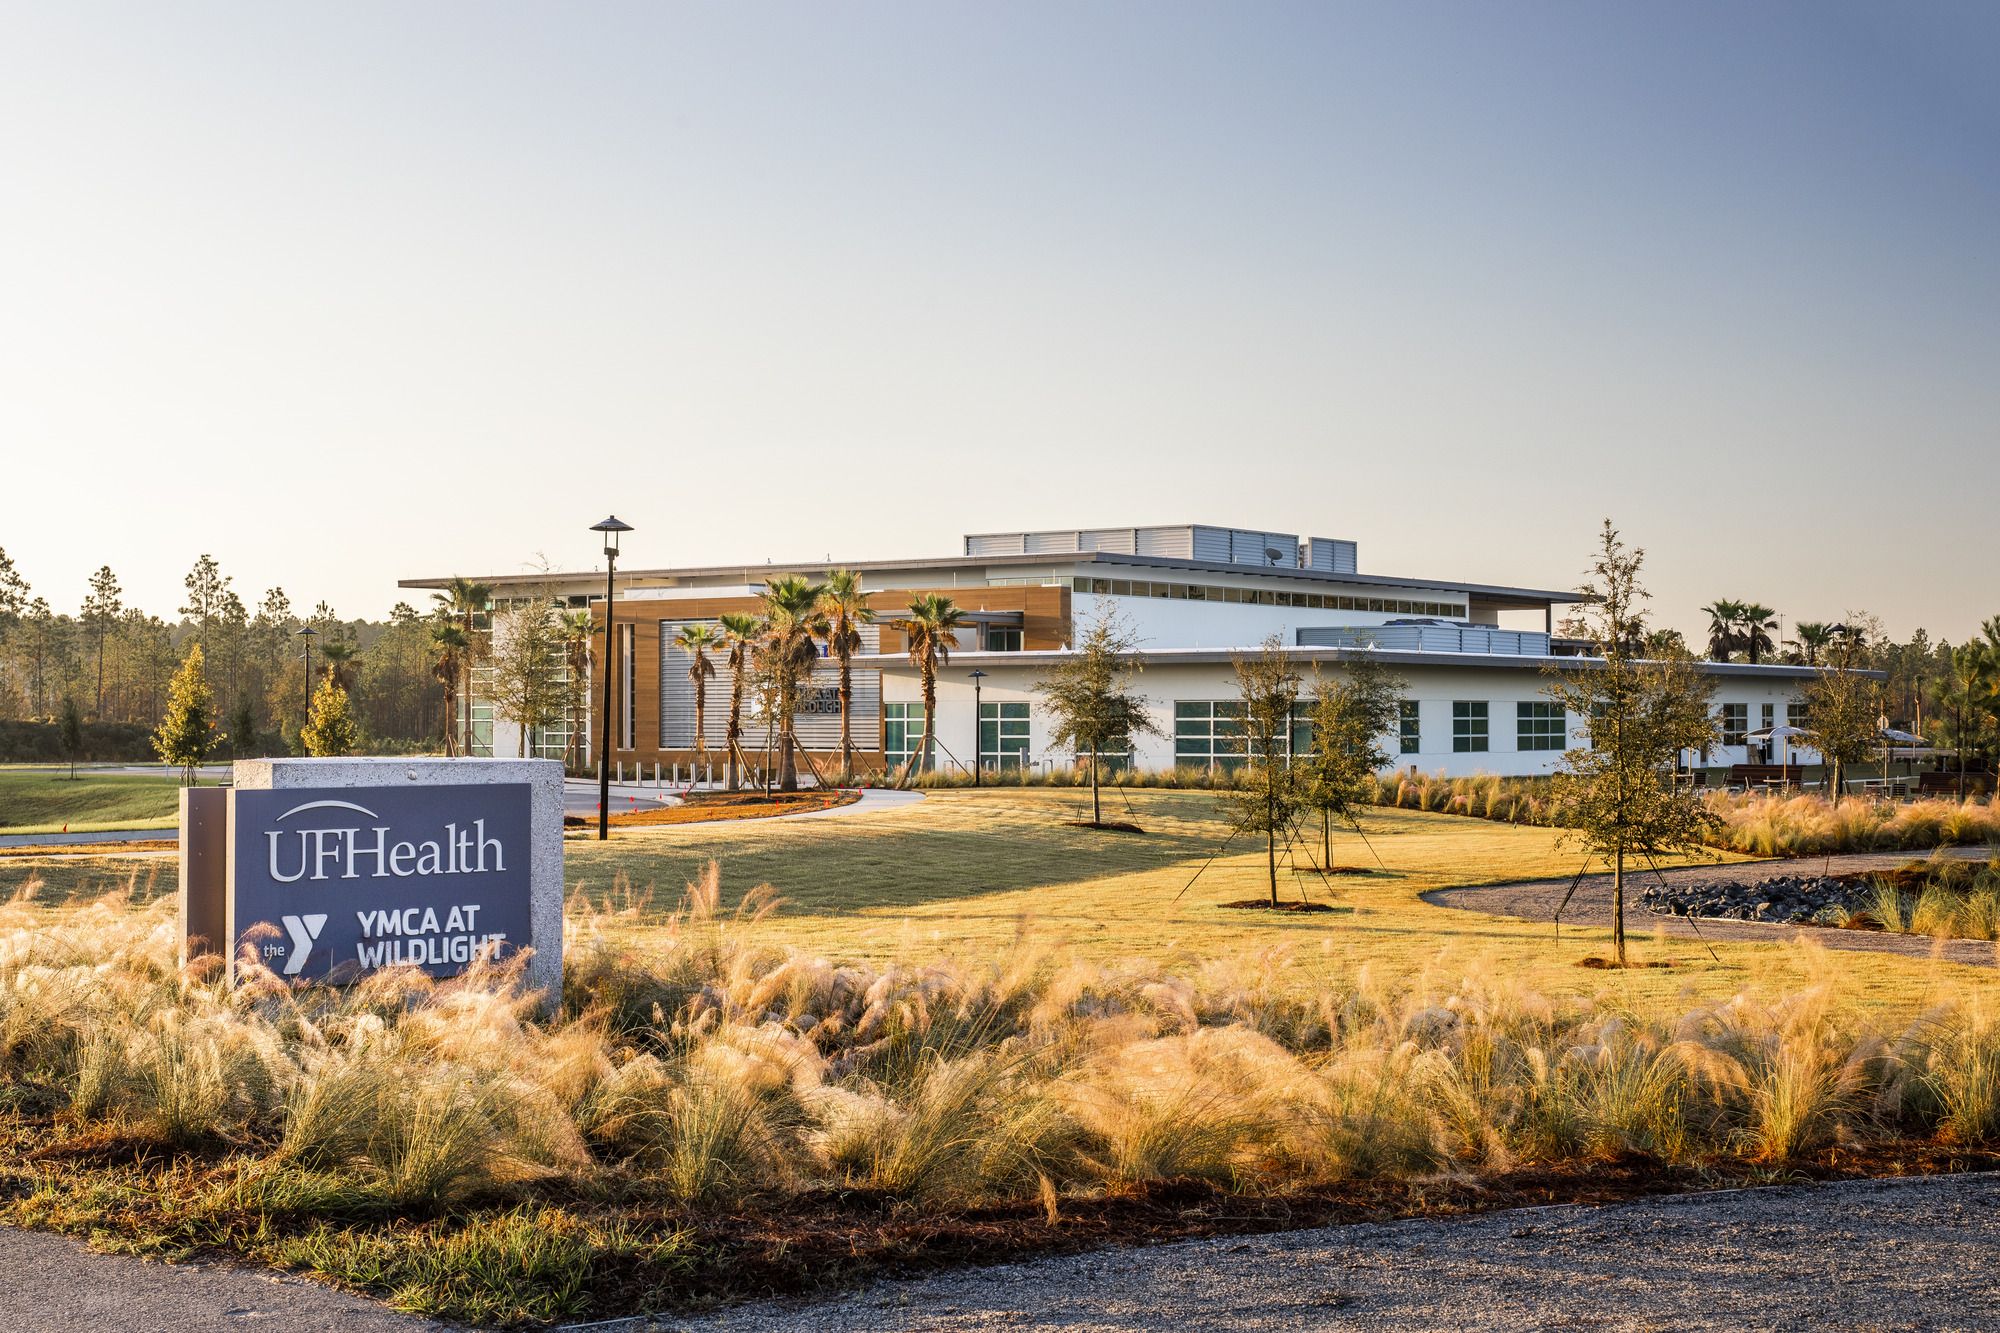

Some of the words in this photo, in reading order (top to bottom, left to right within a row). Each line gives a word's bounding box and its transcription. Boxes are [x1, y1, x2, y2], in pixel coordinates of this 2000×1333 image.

[356, 907, 441, 938] YMCA
[444, 904, 481, 932] AT
[263, 943, 285, 957] the
[356, 933, 507, 969] WILDLIGHT
